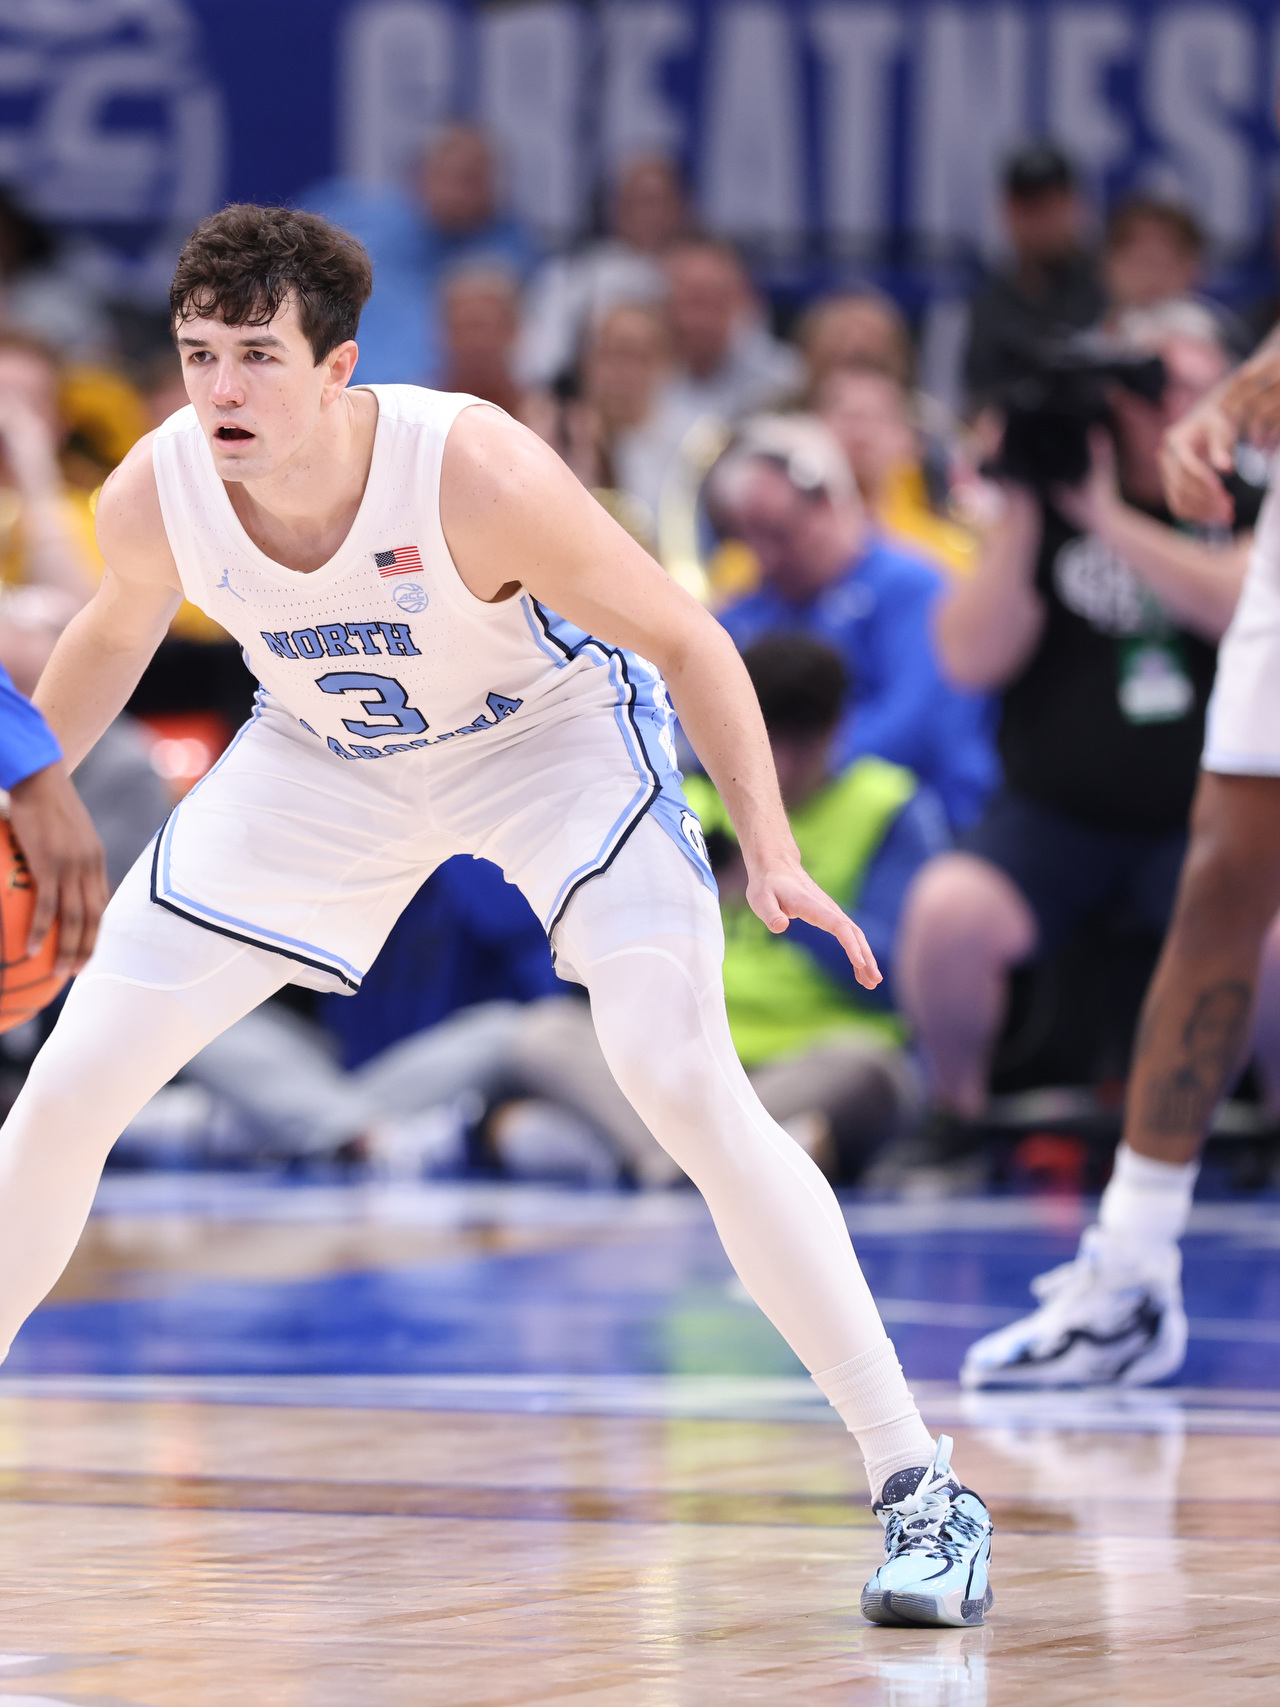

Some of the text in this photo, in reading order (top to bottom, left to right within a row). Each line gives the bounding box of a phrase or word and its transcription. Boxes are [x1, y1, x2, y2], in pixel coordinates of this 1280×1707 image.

[397, 591, 425, 602] ACC
[260, 621, 422, 659] NORTH
[314, 671, 429, 739] 3
